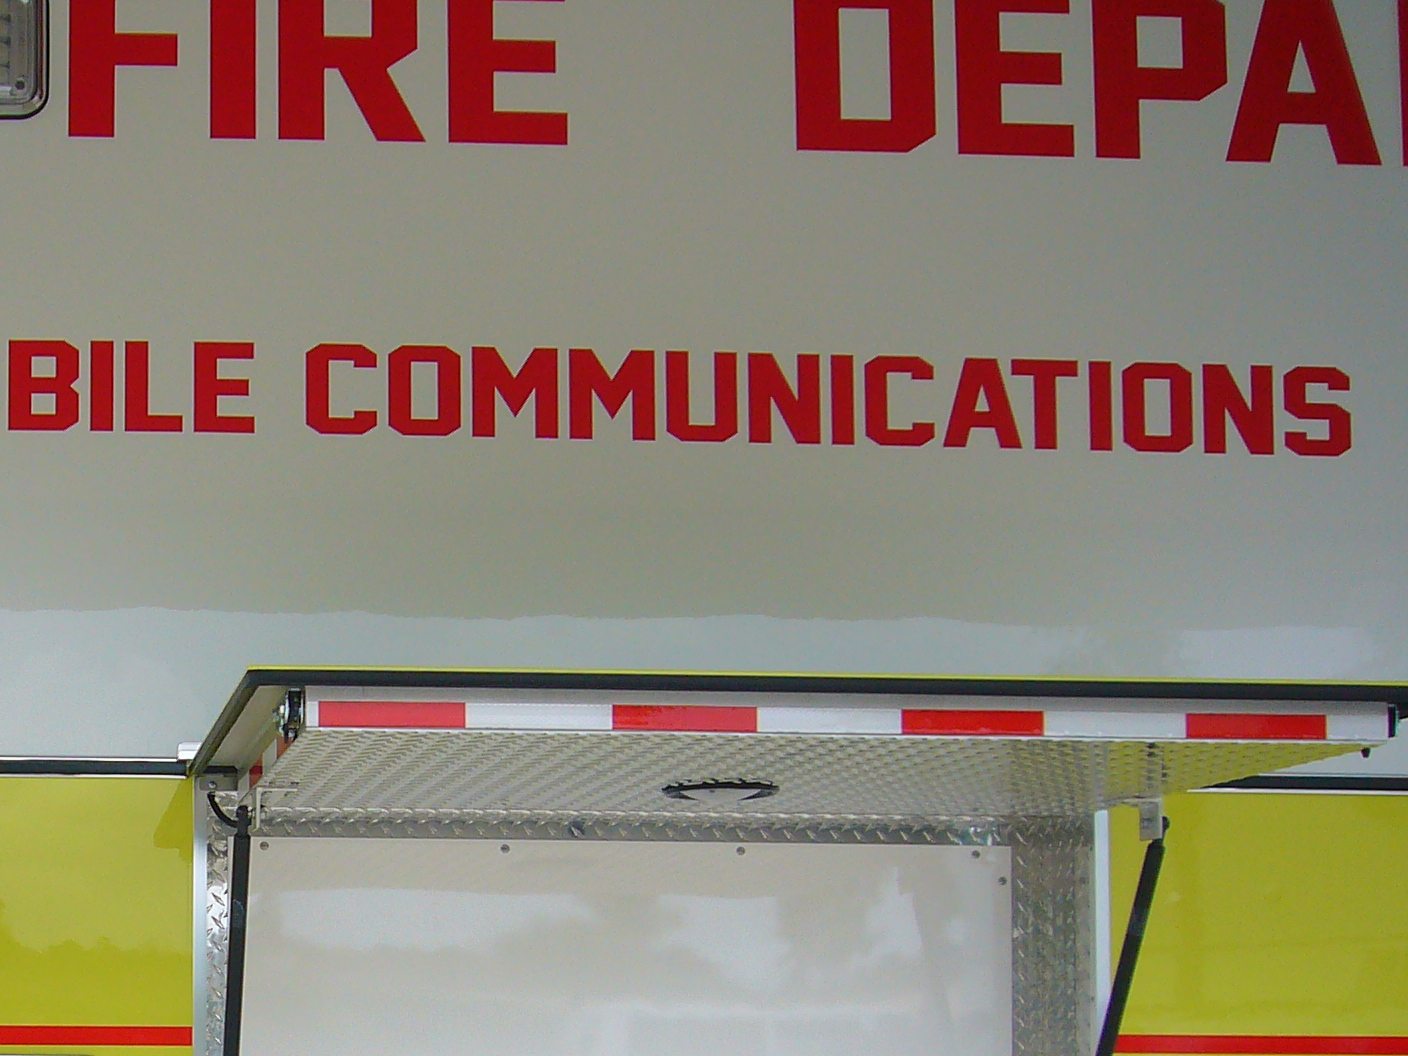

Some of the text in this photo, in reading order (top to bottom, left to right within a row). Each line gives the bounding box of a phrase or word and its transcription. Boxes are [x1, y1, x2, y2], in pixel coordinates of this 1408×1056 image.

[68, 0, 568, 145] FIRE
[793, 0, 1408, 167] DEPA
[305, 342, 1352, 457] COMMUNICATIONS
